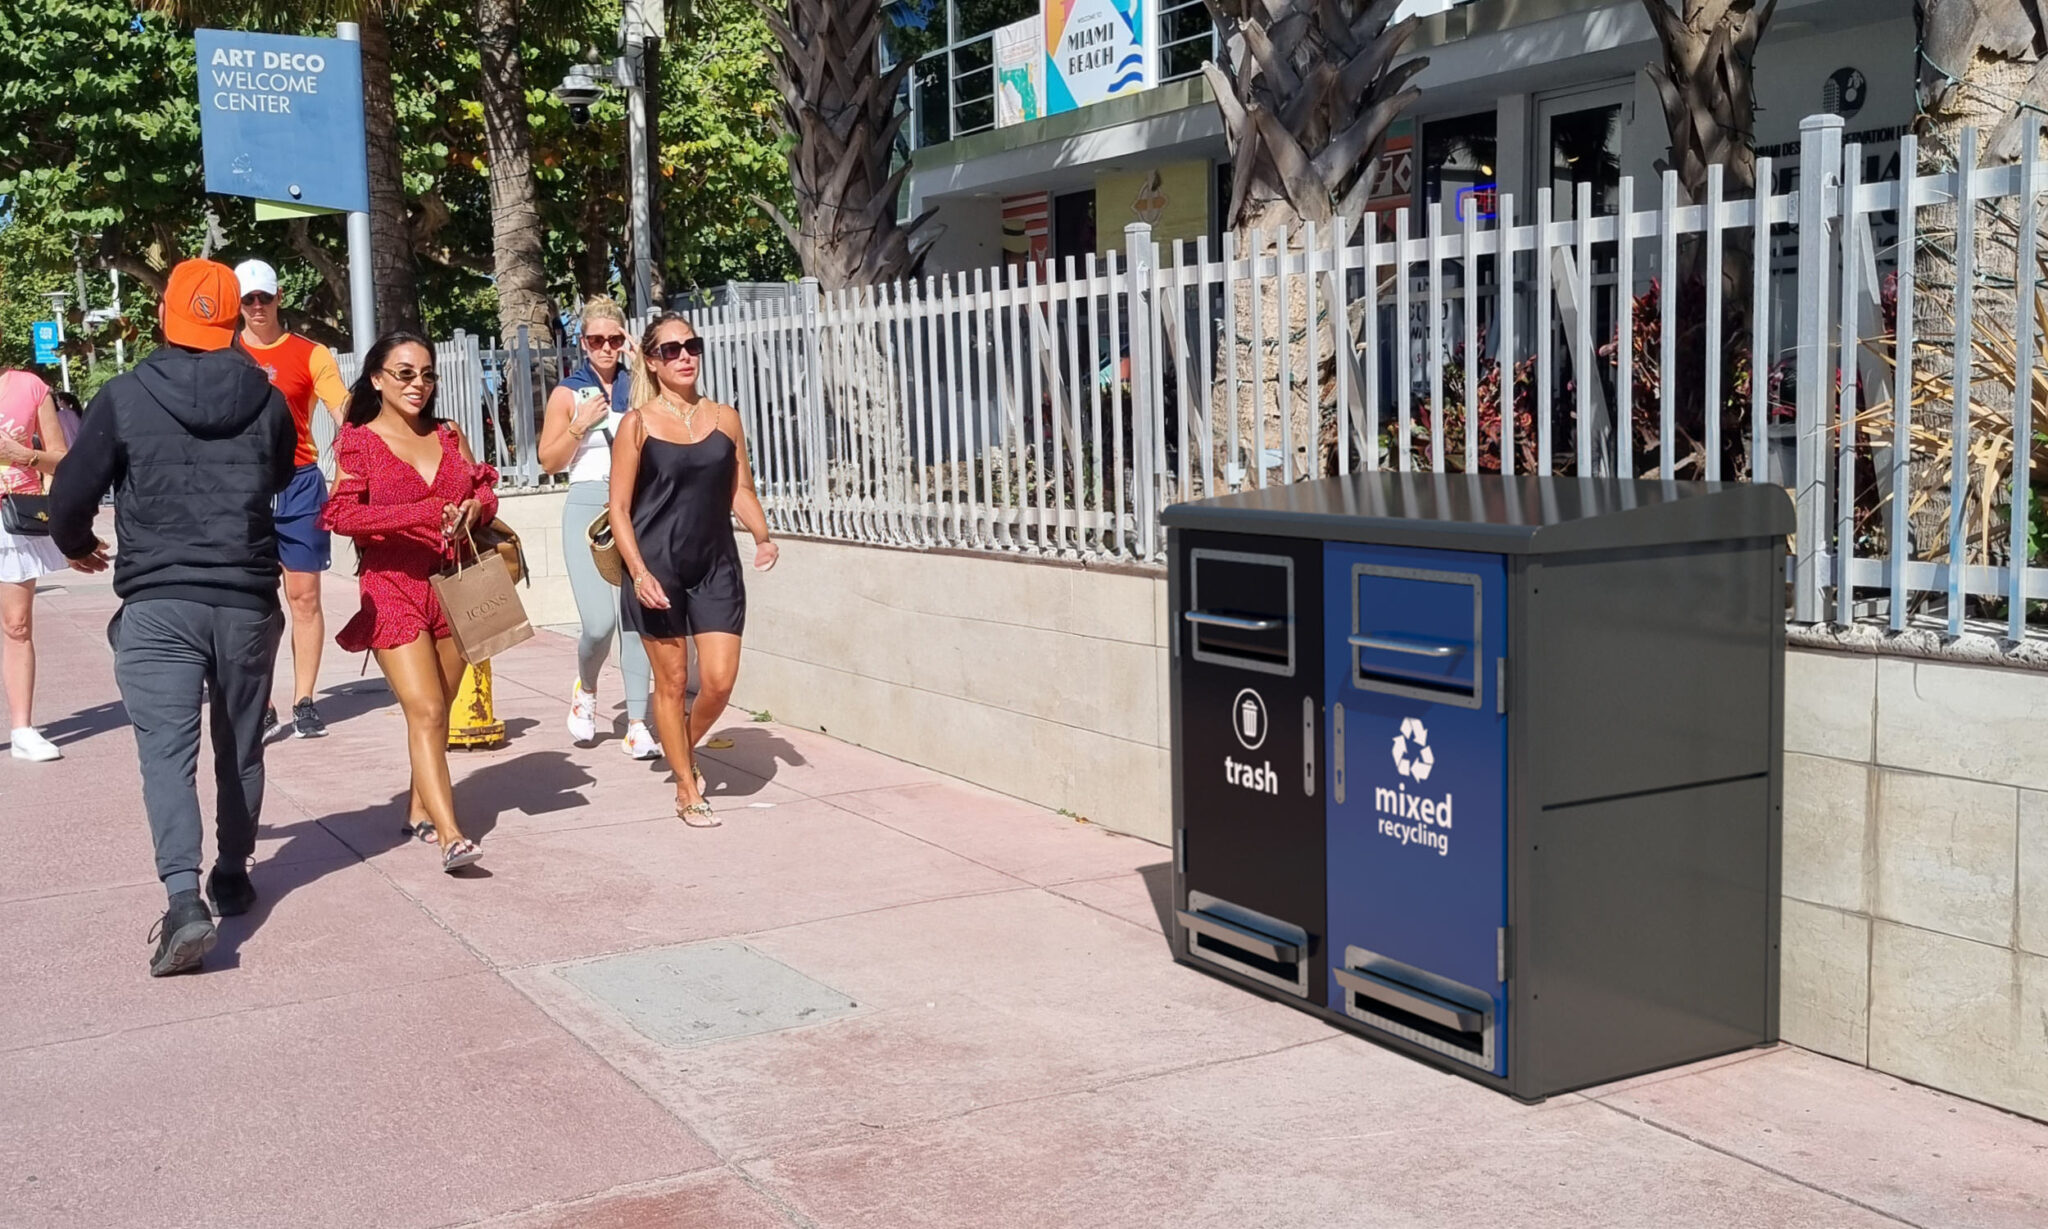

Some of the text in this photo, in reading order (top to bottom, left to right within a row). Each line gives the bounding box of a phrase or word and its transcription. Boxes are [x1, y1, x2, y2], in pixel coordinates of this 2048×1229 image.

[1068, 22, 1114, 52] MIAMI
[211, 48, 325, 73] ART DECO
[1069, 46, 1114, 76] BEACH
[212, 70, 318, 94] WELCOME
[214, 92, 291, 114] CENTER
[466, 593, 508, 621] ICONS
[1224, 756, 1278, 795] trash
[1375, 782, 1452, 829] mixed
[1378, 818, 1448, 856] recycling
